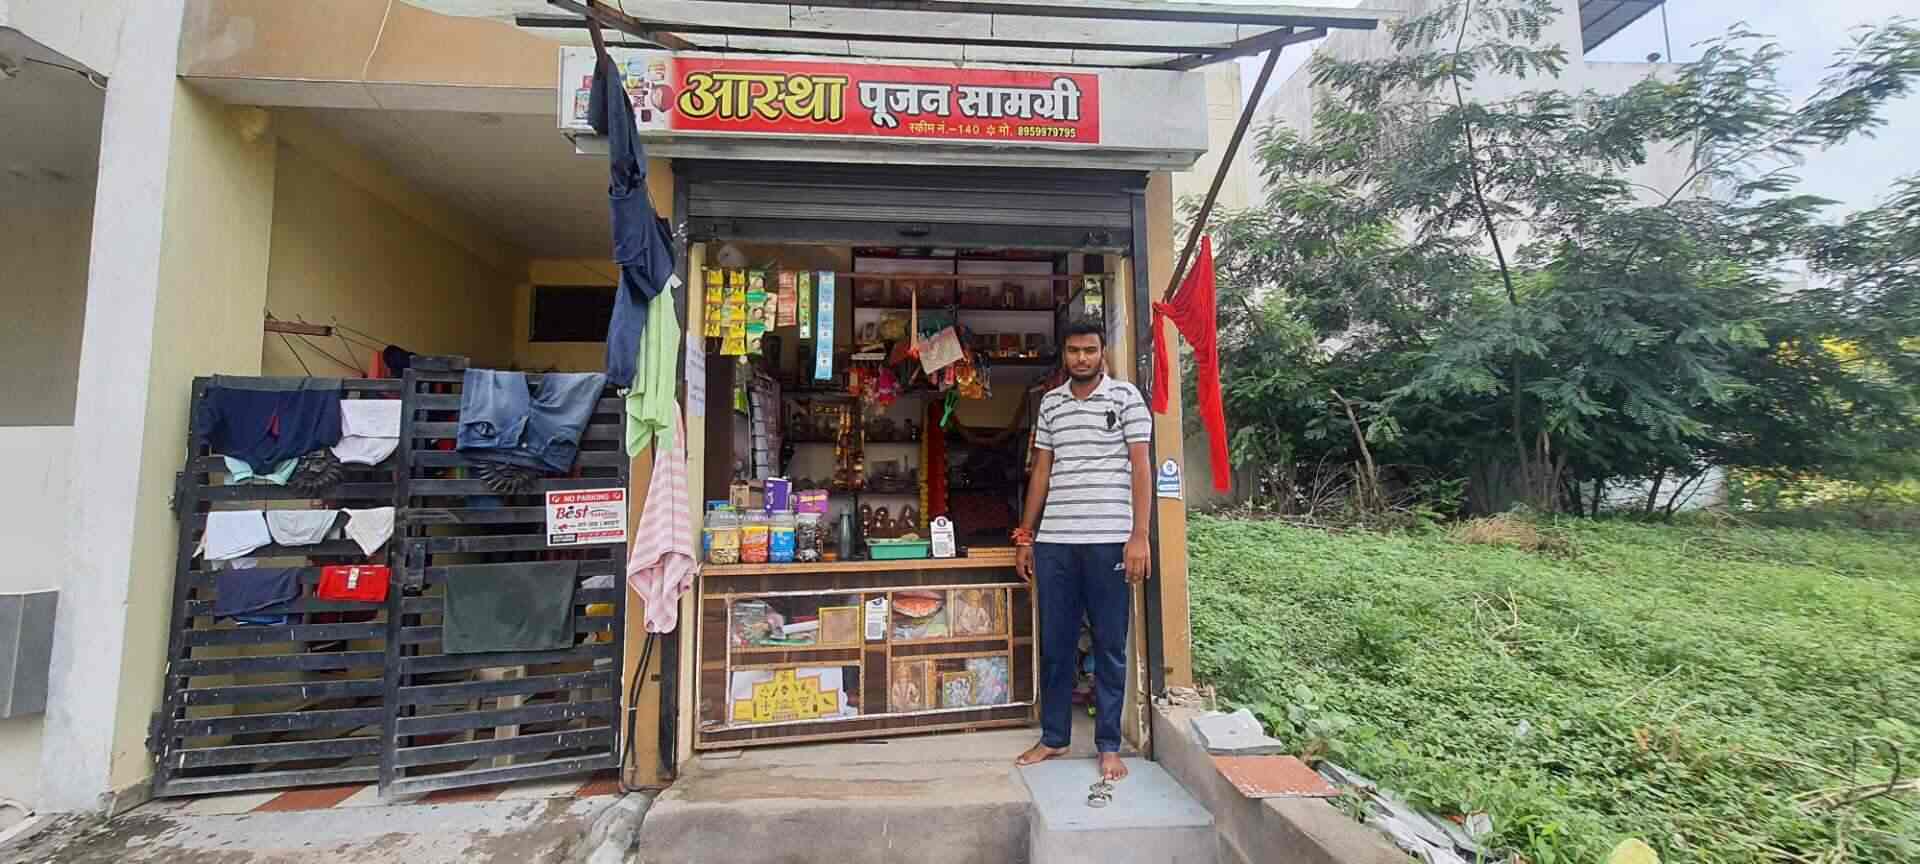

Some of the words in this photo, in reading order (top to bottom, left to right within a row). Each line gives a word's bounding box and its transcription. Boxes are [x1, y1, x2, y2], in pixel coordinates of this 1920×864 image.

[680, 72, 848, 122] आस्था
[858, 81, 952, 128] पूजन
[957, 78, 1081, 121] सामग्री
[908, 119, 934, 134] स्कीम
[563, 495, 576, 503] NO
[577, 493, 609, 502] PARKING
[556, 505, 588, 520] Best
